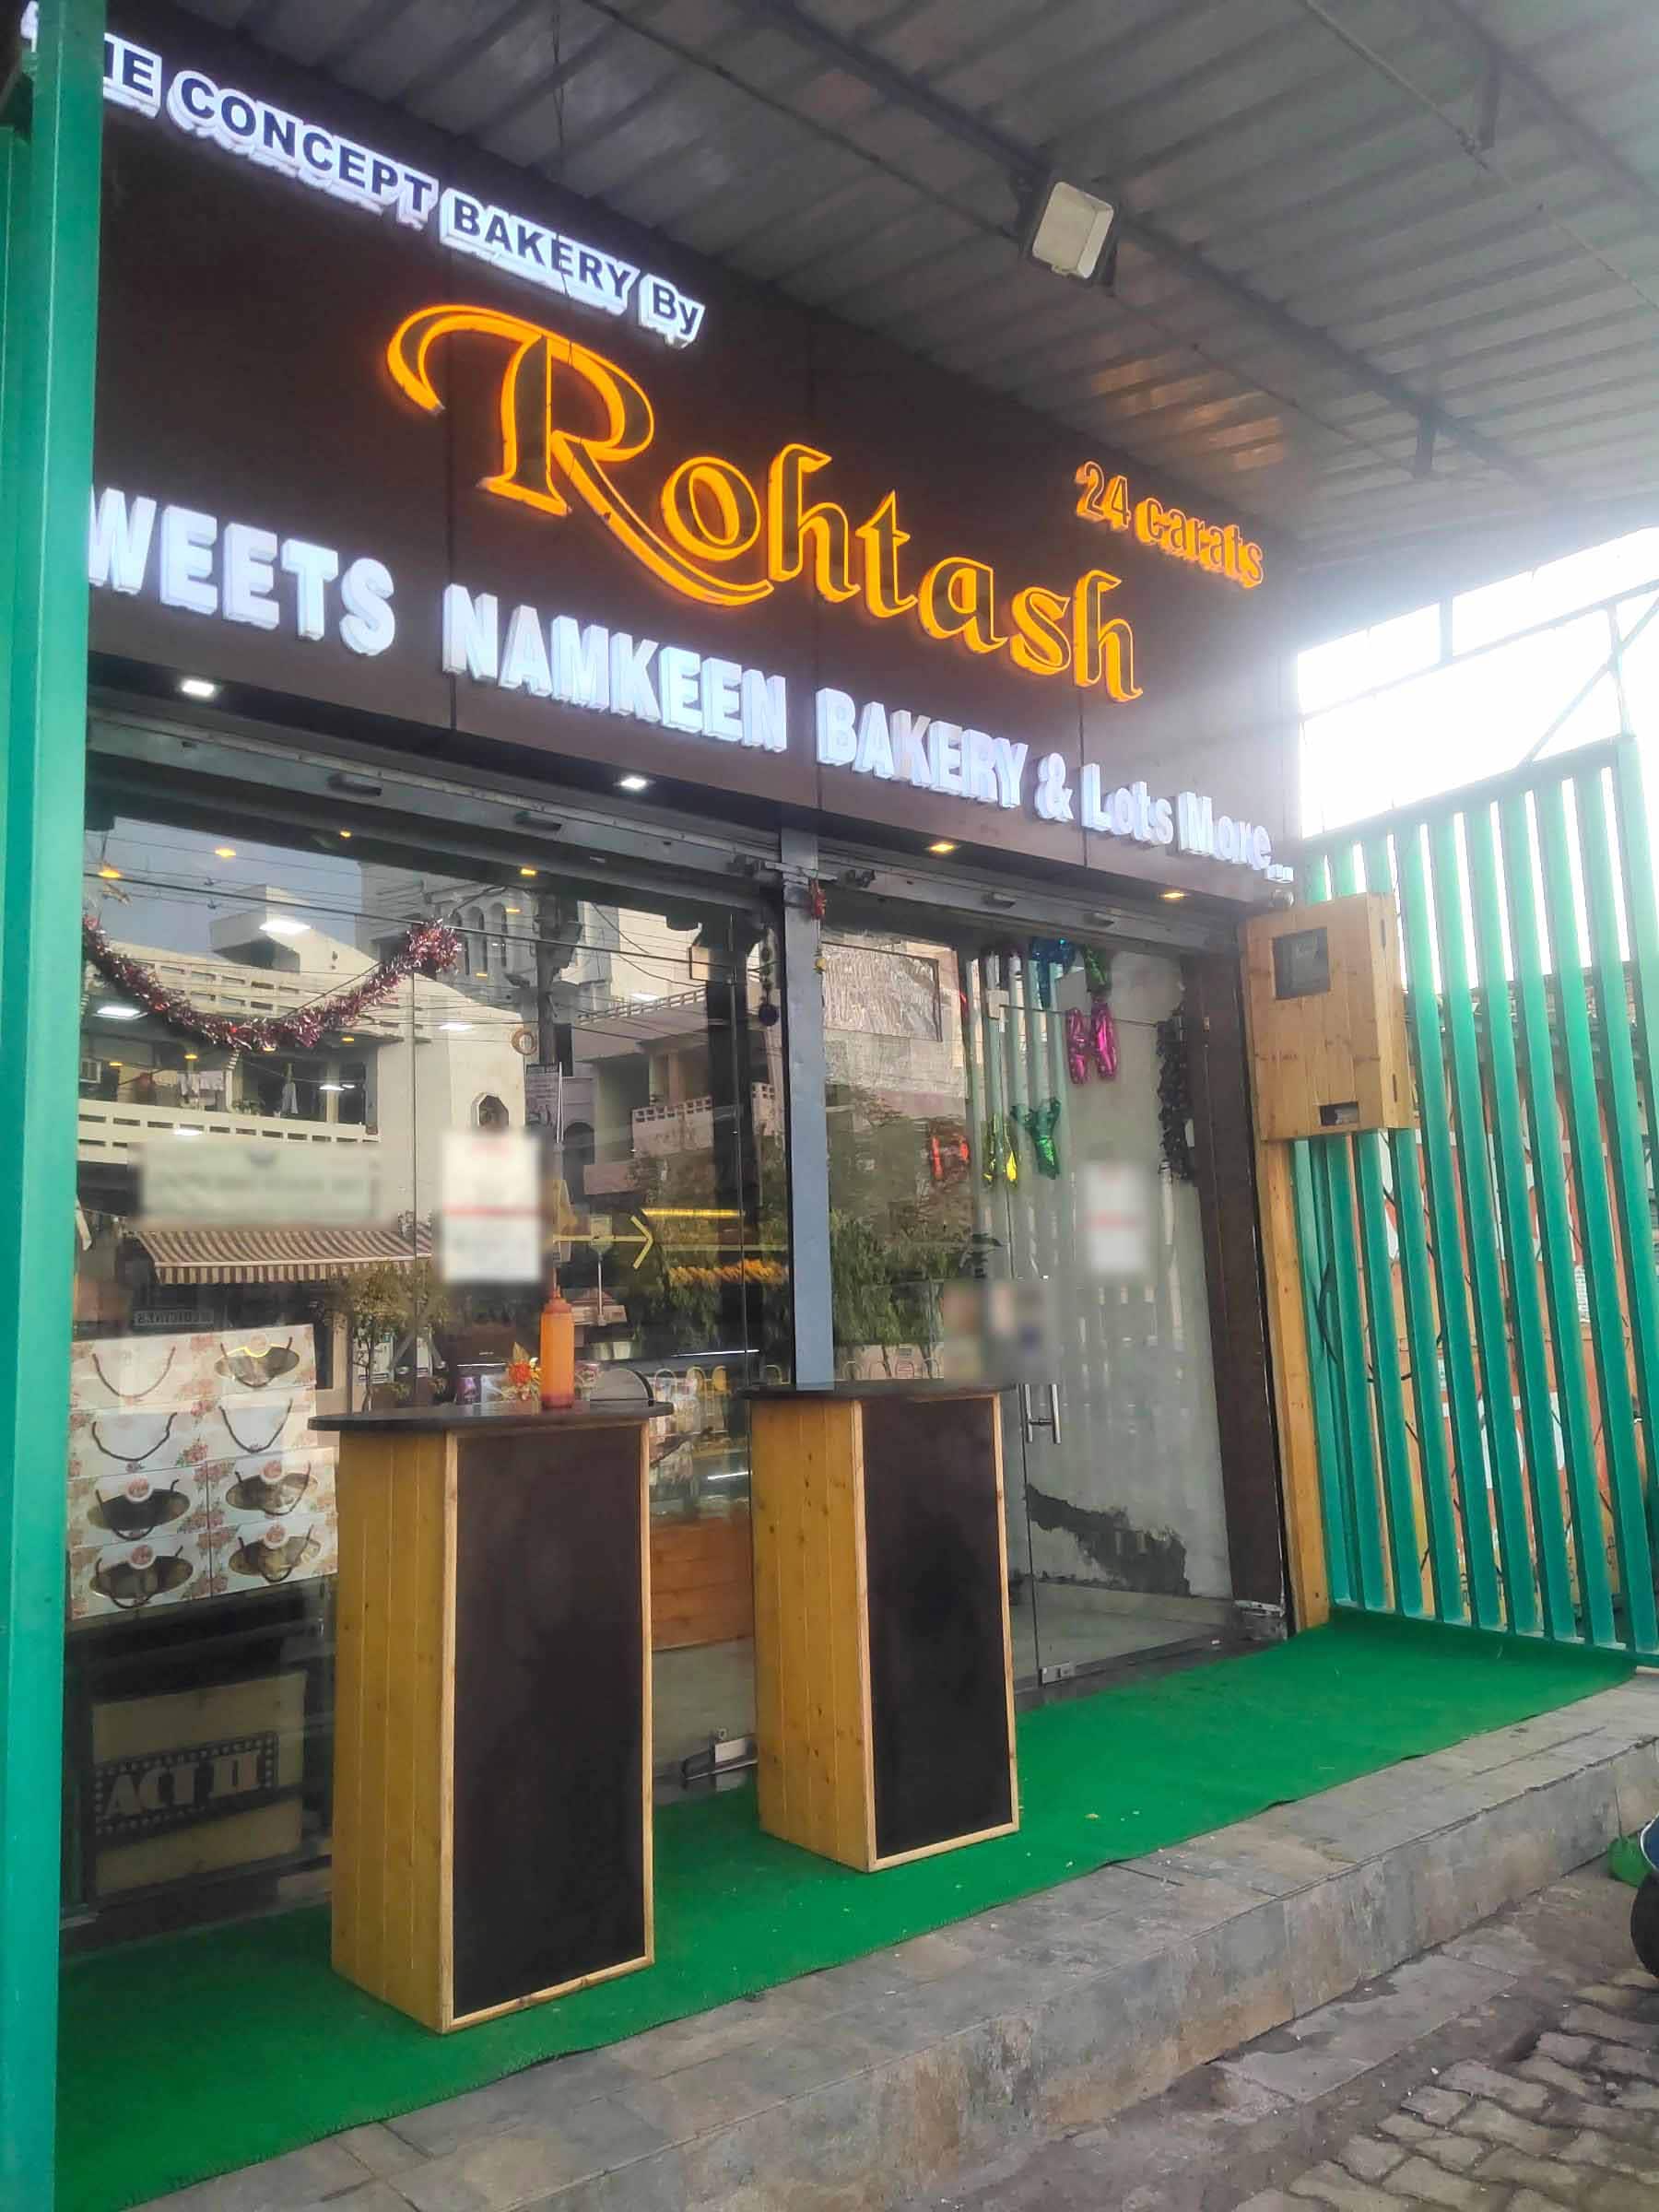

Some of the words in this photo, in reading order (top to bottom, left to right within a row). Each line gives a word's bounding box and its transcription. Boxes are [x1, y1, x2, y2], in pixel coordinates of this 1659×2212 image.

[169, 71, 437, 229] CONCEPT
[441, 188, 639, 313] BAKERY
[641, 276, 704, 347] By
[385, 302, 1143, 702] Rohtash
[1075, 460, 1131, 531] 24
[88, 484, 396, 656] WEETS
[442, 584, 787, 754] NAMKEEN
[816, 687, 1030, 809] BAKERY
[1034, 753, 1074, 822] &
[1080, 762, 1174, 846] Lots
[103, 1762, 200, 1821] ACT
